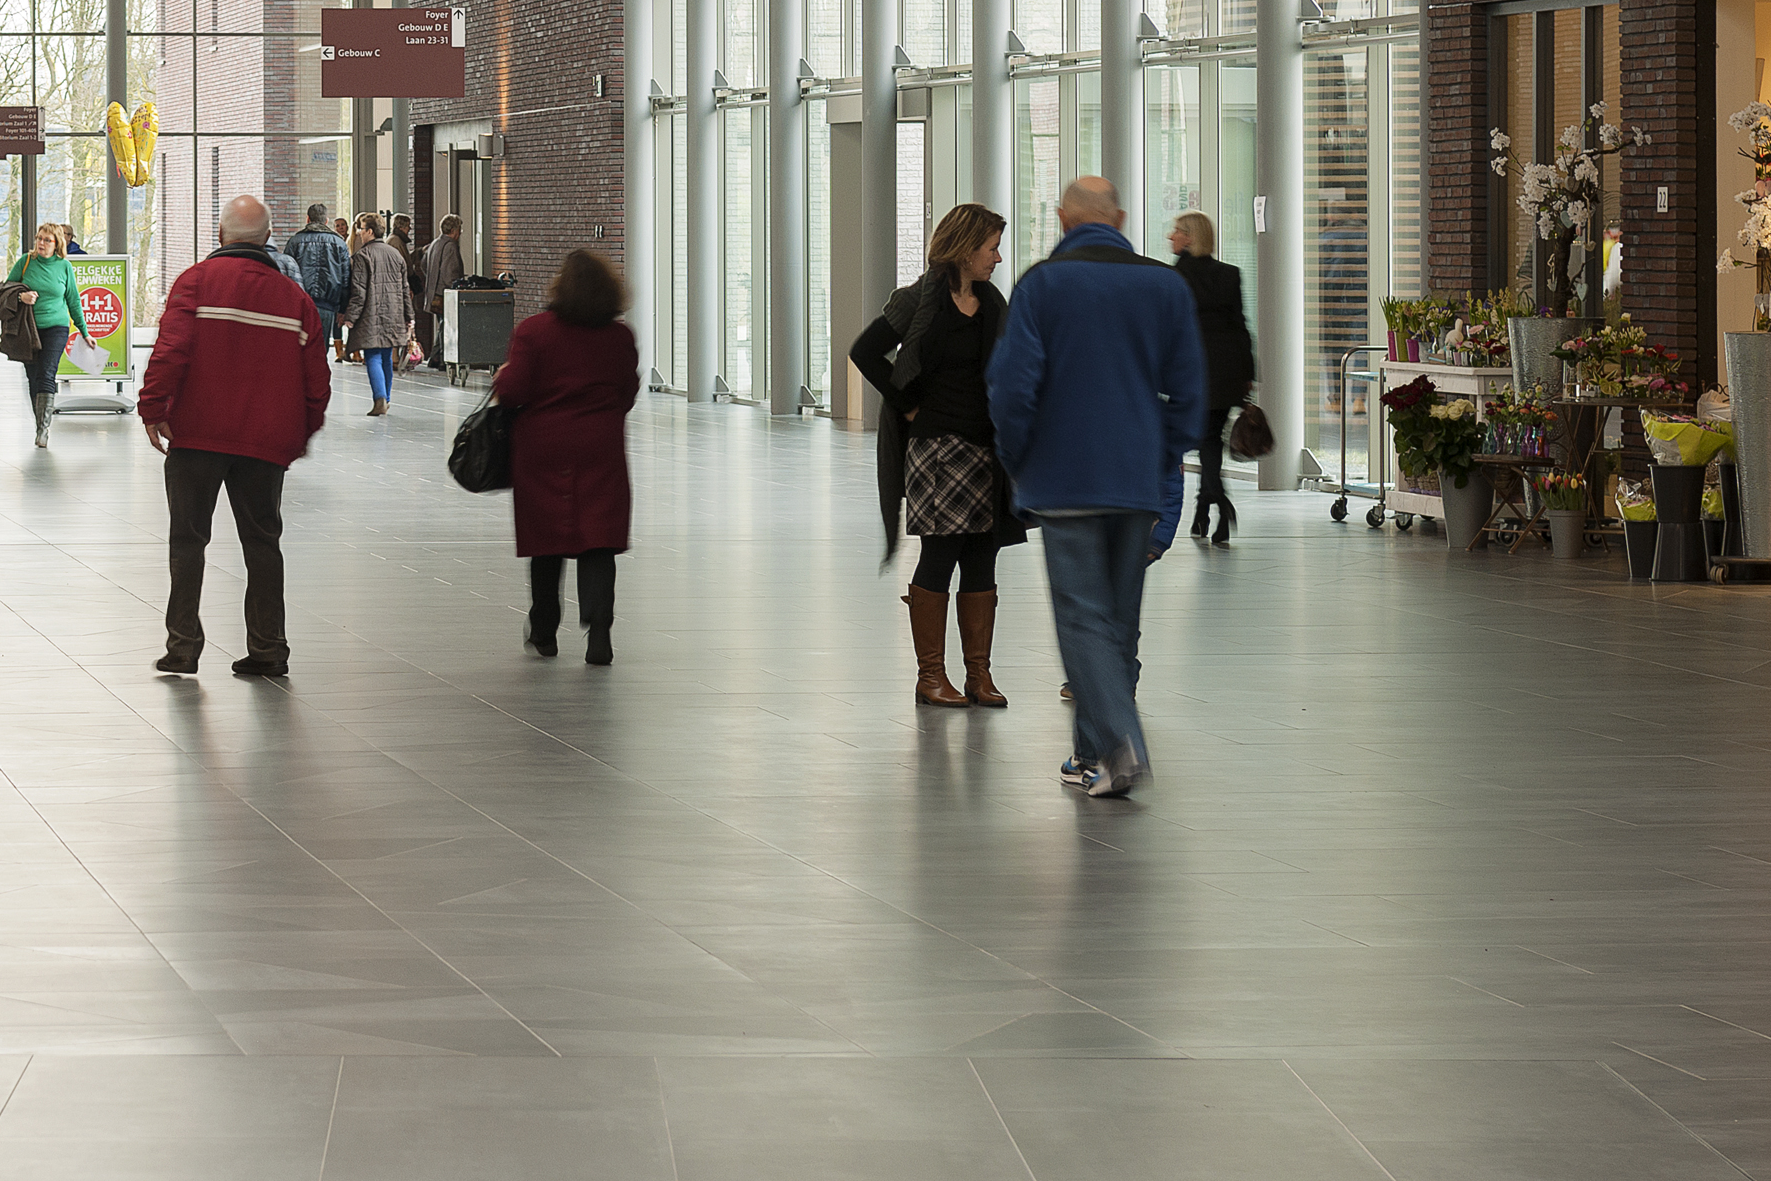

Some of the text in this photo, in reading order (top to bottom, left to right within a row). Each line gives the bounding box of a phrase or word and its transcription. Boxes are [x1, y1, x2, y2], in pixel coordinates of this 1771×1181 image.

[425, 10, 449, 21] Foyer
[398, 23, 449, 32] Gebouw D E
[405, 36, 449, 45] Laan 23-31
[337, 48, 381, 57] Gebouw C
[1659, 191, 1667, 209] 22
[75, 275, 122, 285] ENWEKEN
[80, 293, 114, 311] 1+1
[84, 311, 119, 323] RATIS
